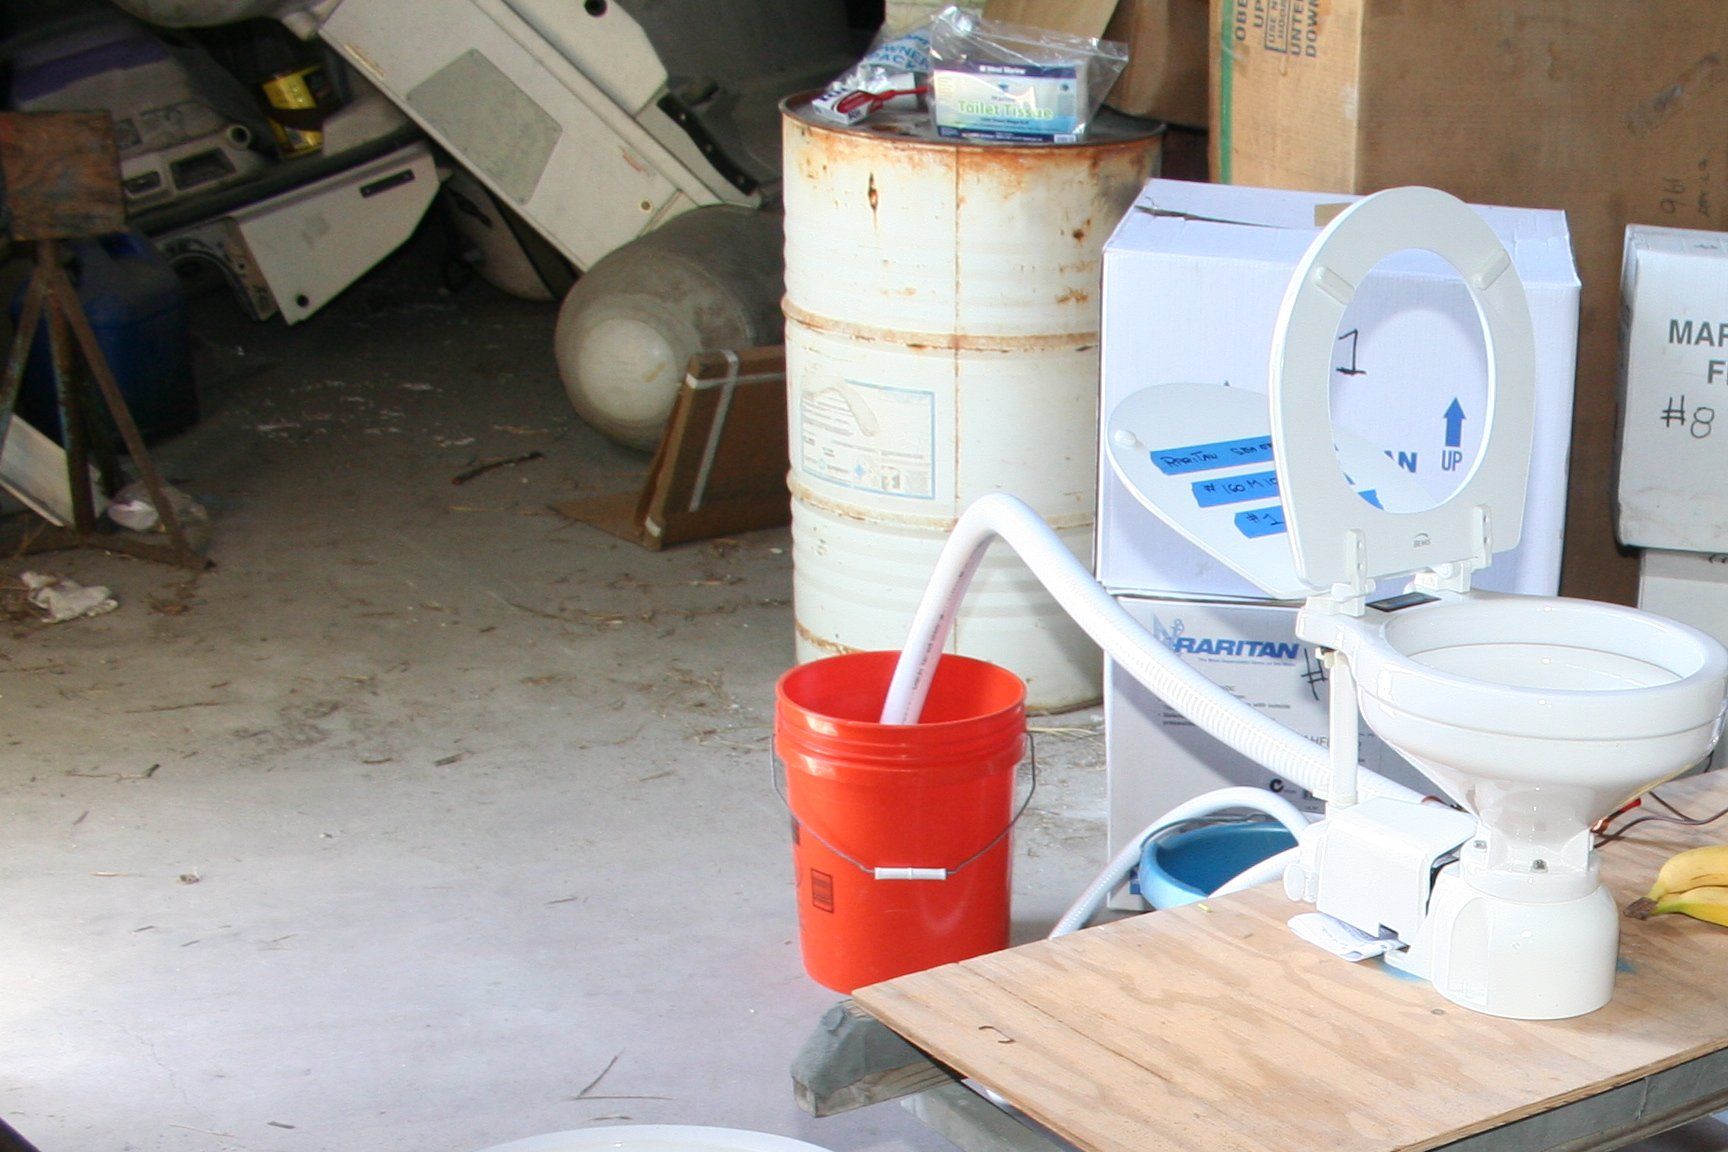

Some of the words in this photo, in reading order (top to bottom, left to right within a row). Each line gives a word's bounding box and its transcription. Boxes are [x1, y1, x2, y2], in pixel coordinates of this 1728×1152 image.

[1290, 0, 1303, 55] UNTE
[958, 100, 999, 116] Toilet
[1004, 104, 1054, 120] Tissue
[1661, 395, 1715, 439] #8
[1441, 450, 1463, 471] UP
[1174, 637, 1300, 659] RARITAN
